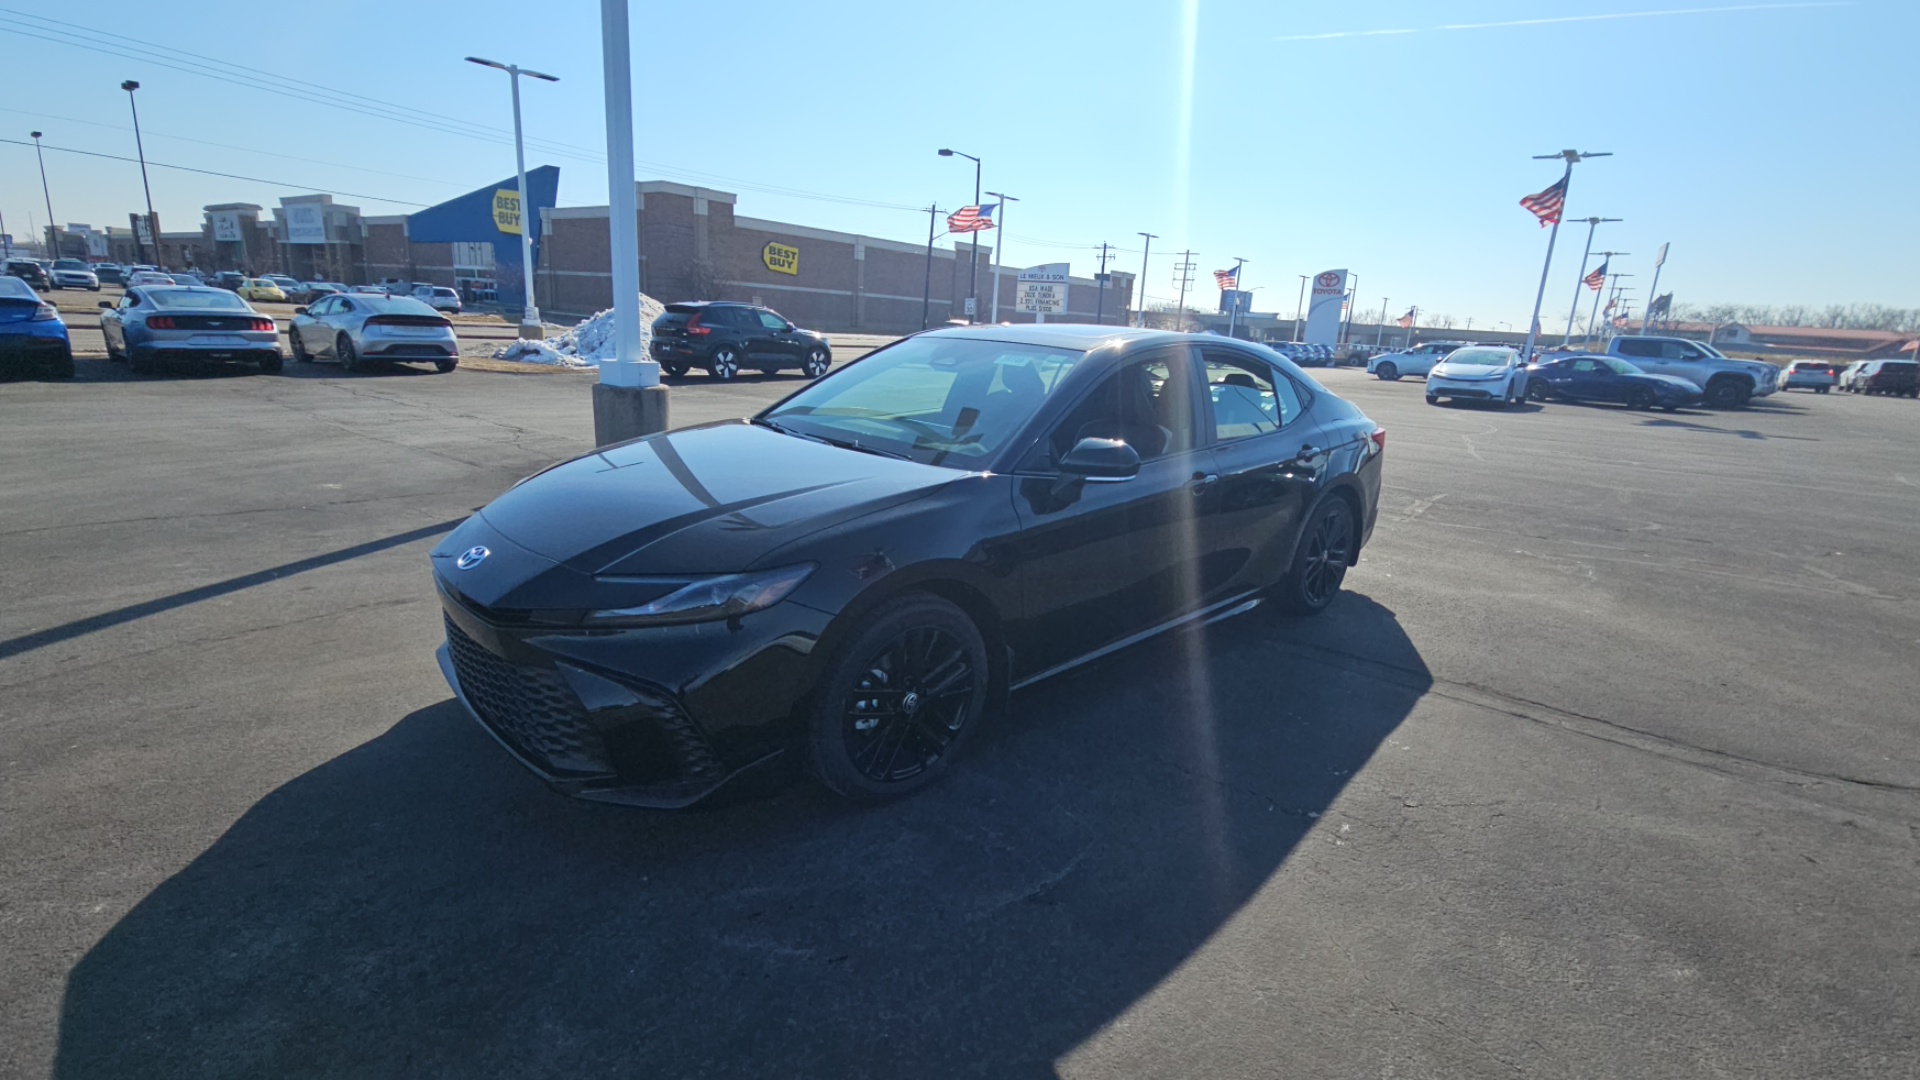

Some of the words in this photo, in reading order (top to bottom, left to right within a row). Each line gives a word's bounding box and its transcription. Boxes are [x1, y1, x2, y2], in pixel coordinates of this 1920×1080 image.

[498, 211, 521, 227] BUY
[769, 245, 797, 260] BEST
[769, 256, 794, 269] BUY
